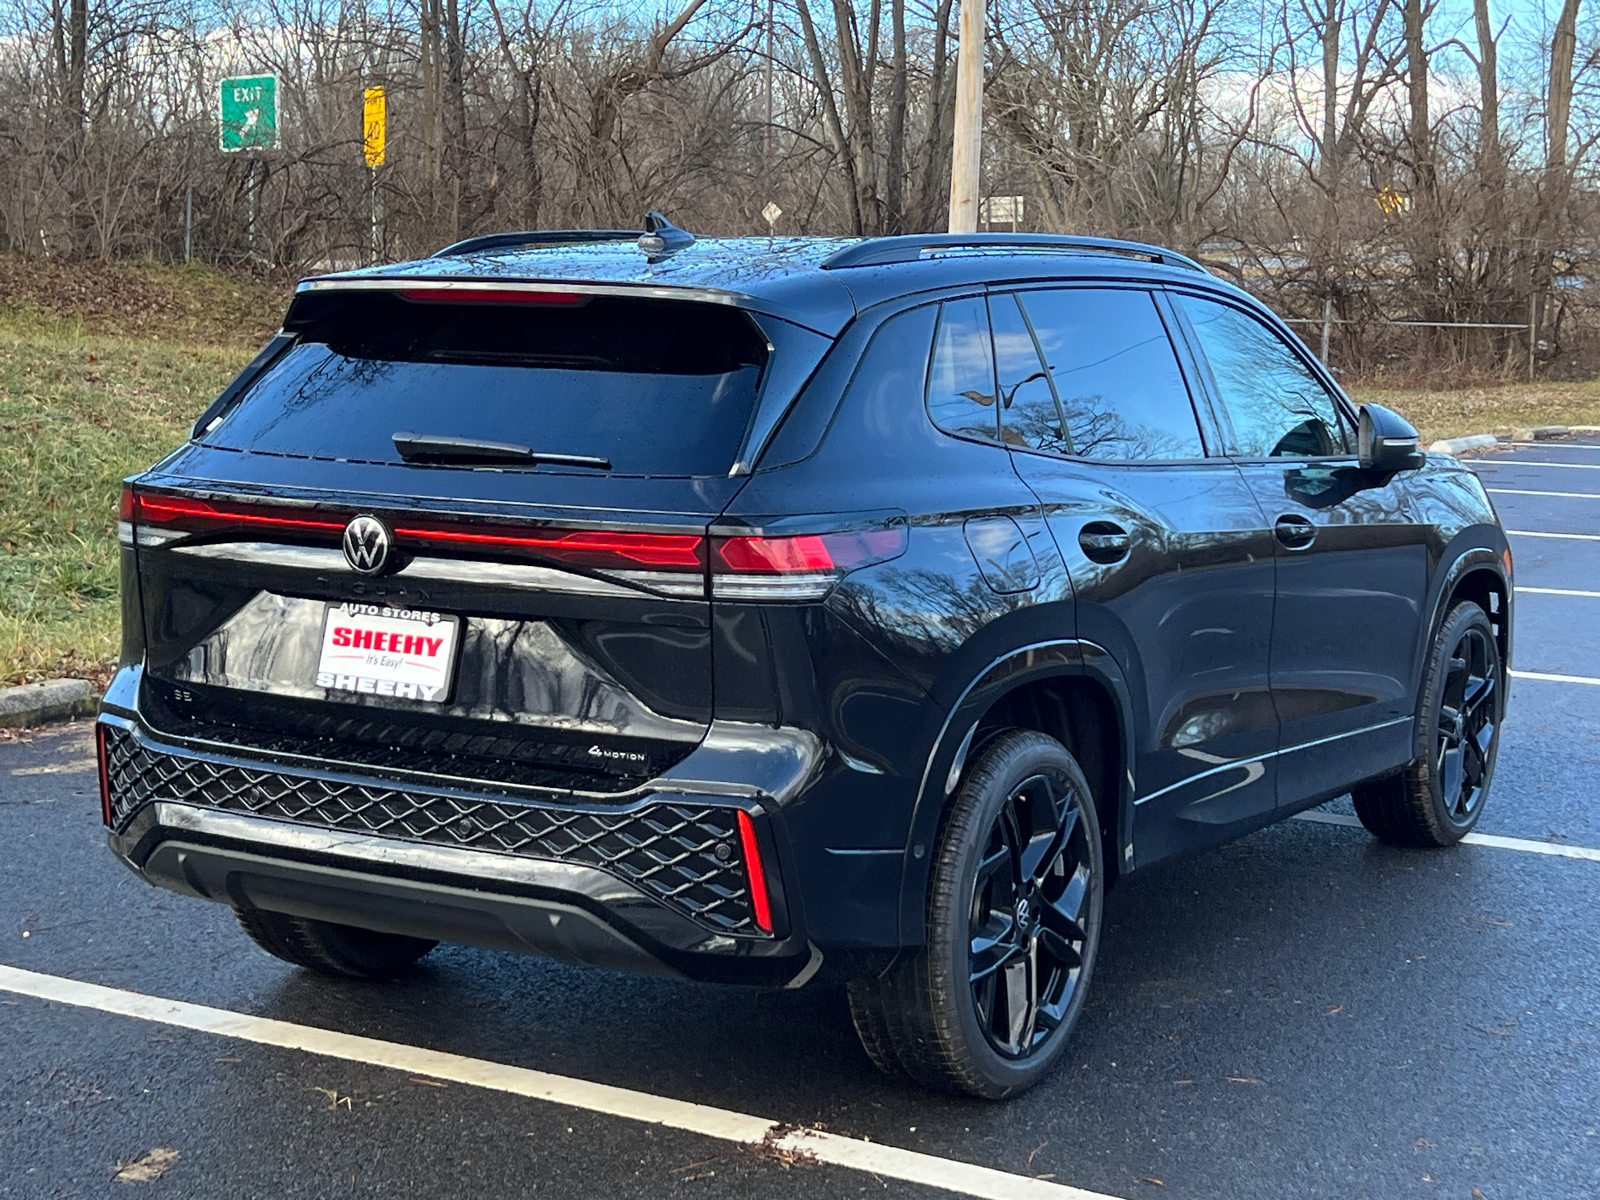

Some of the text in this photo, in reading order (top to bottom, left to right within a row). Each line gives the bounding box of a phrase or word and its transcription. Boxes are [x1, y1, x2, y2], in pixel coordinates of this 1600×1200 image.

[234, 86, 262, 102] EXIT
[339, 603, 441, 622] AUTO STORES
[332, 626, 444, 657] SHEEHY
[366, 654, 404, 670] It's Easy!
[316, 672, 441, 701] SHEEHY
